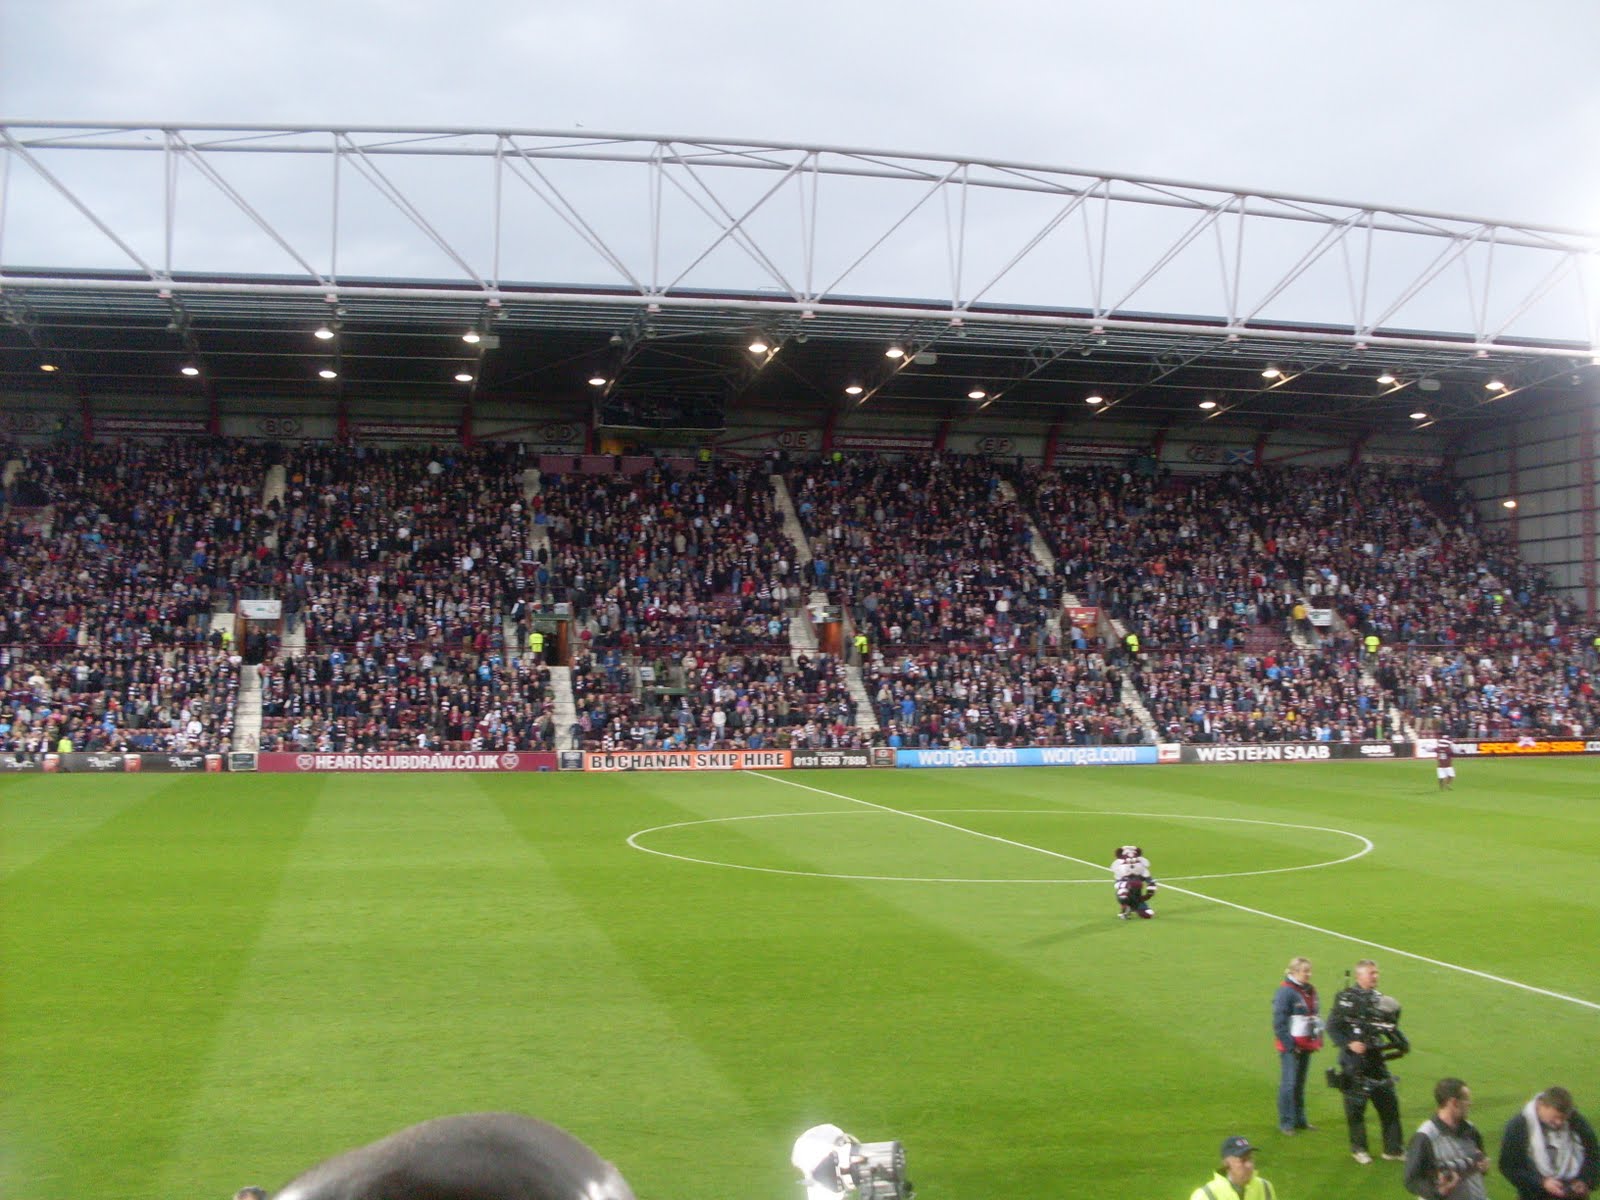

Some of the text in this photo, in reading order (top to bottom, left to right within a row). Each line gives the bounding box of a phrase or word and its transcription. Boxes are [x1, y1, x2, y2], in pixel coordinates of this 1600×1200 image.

[592, 754, 690, 769] BUCHANAN
[697, 753, 738, 767] SKIP
[744, 752, 785, 766] HIRE
[918, 749, 1018, 767] wonga.com
[1041, 747, 1137, 765] wonga.com
[1196, 745, 1331, 761] WESTERN SAAB
[315, 754, 500, 770] HEARTSCLUBDRAW.CO.UK
[793, 756, 819, 767] 0131
